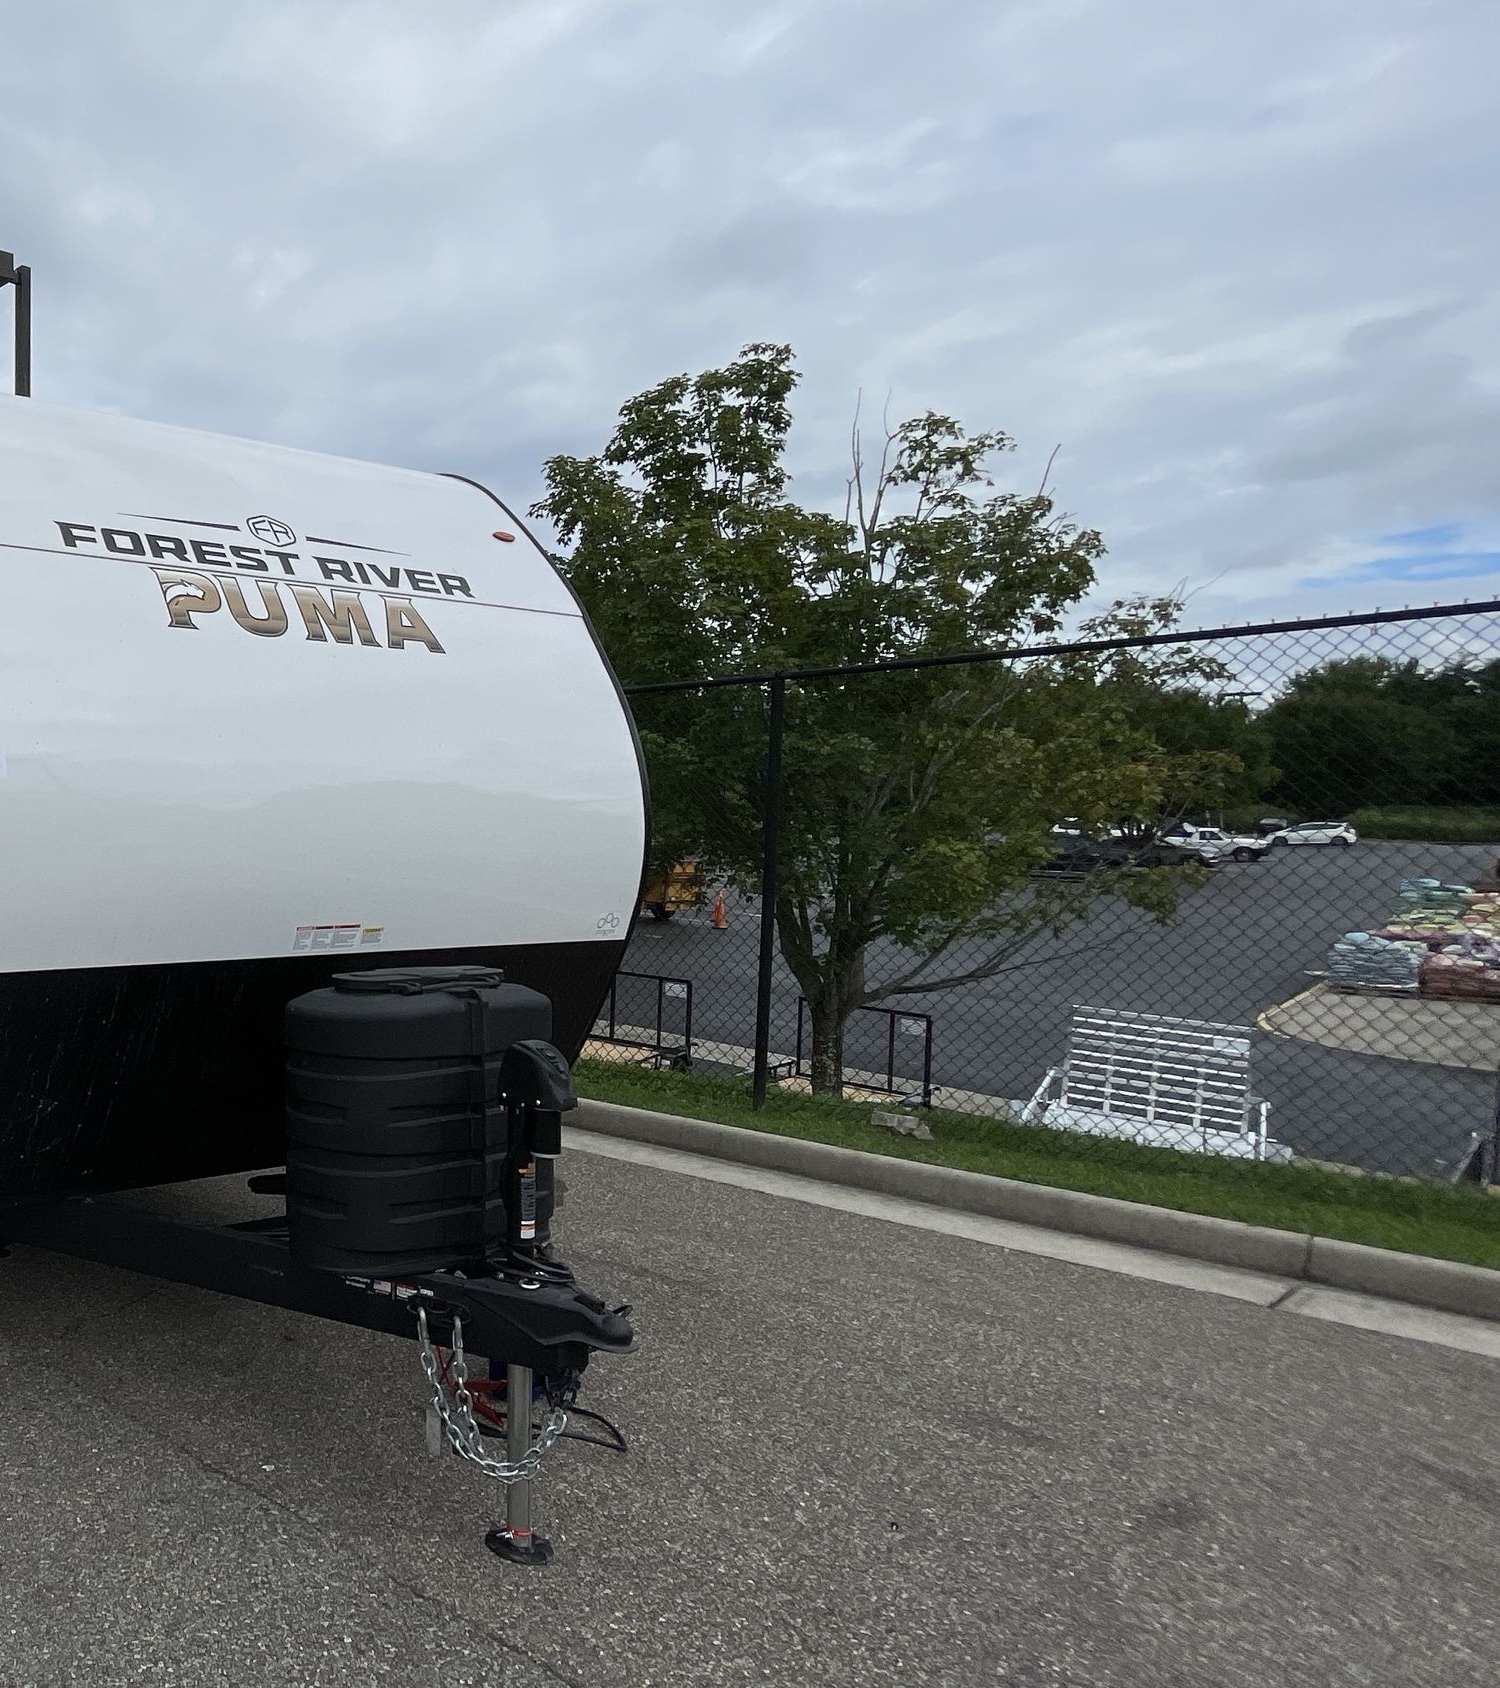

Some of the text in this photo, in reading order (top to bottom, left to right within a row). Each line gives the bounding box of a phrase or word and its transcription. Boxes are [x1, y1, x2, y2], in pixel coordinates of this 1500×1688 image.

[53, 520, 476, 599] FOREST RIVER
[148, 566, 446, 655] PUMA
